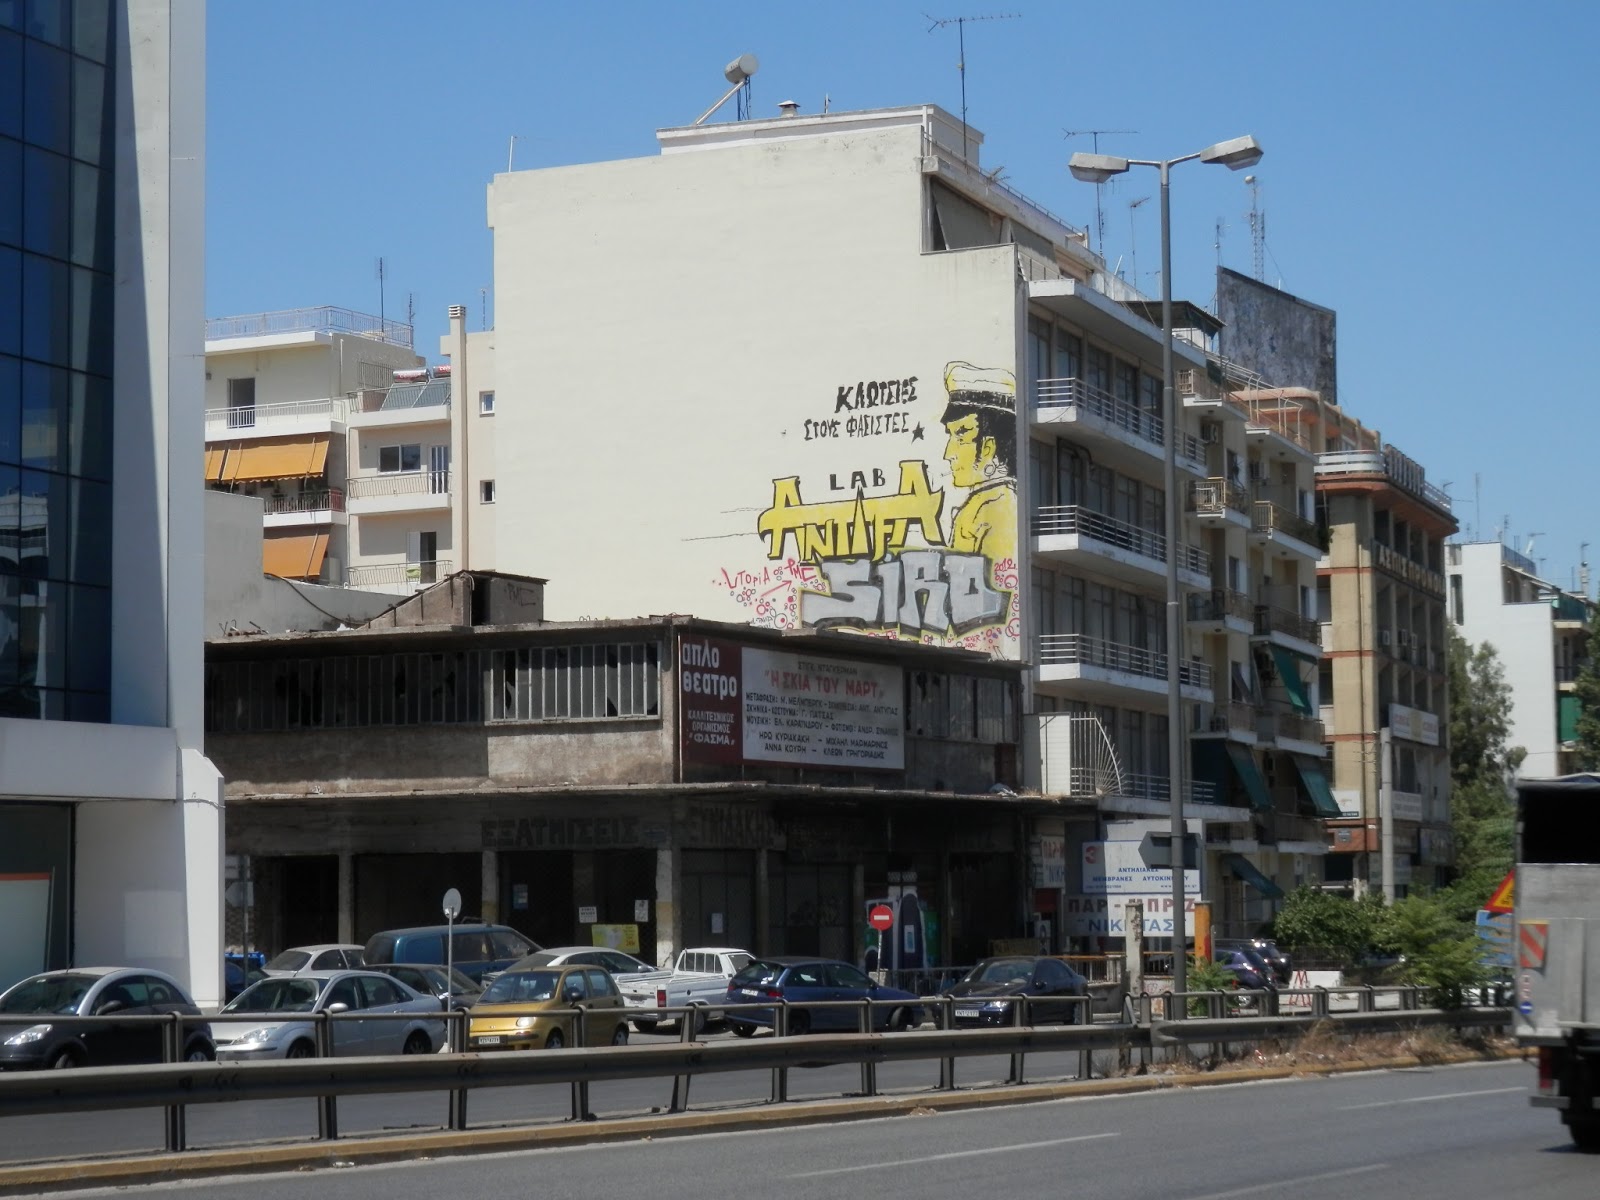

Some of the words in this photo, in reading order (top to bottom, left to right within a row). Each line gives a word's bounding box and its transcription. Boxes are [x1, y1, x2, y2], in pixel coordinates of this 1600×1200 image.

[834, 376, 919, 413] ΚΛΩΤΣΙΕΣ
[804, 418, 841, 441] ΣΤΟΥΣ
[846, 412, 909, 437] ΦΑΣΙΣΤΕΣ
[829, 468, 886, 491] LAB
[757, 459, 945, 566] ANTIFA
[783, 671, 811, 692] ΣΚΙΑ
[815, 676, 839, 694] ΤΟΥ
[764, 743, 782, 752] ΑΝΝΑ
